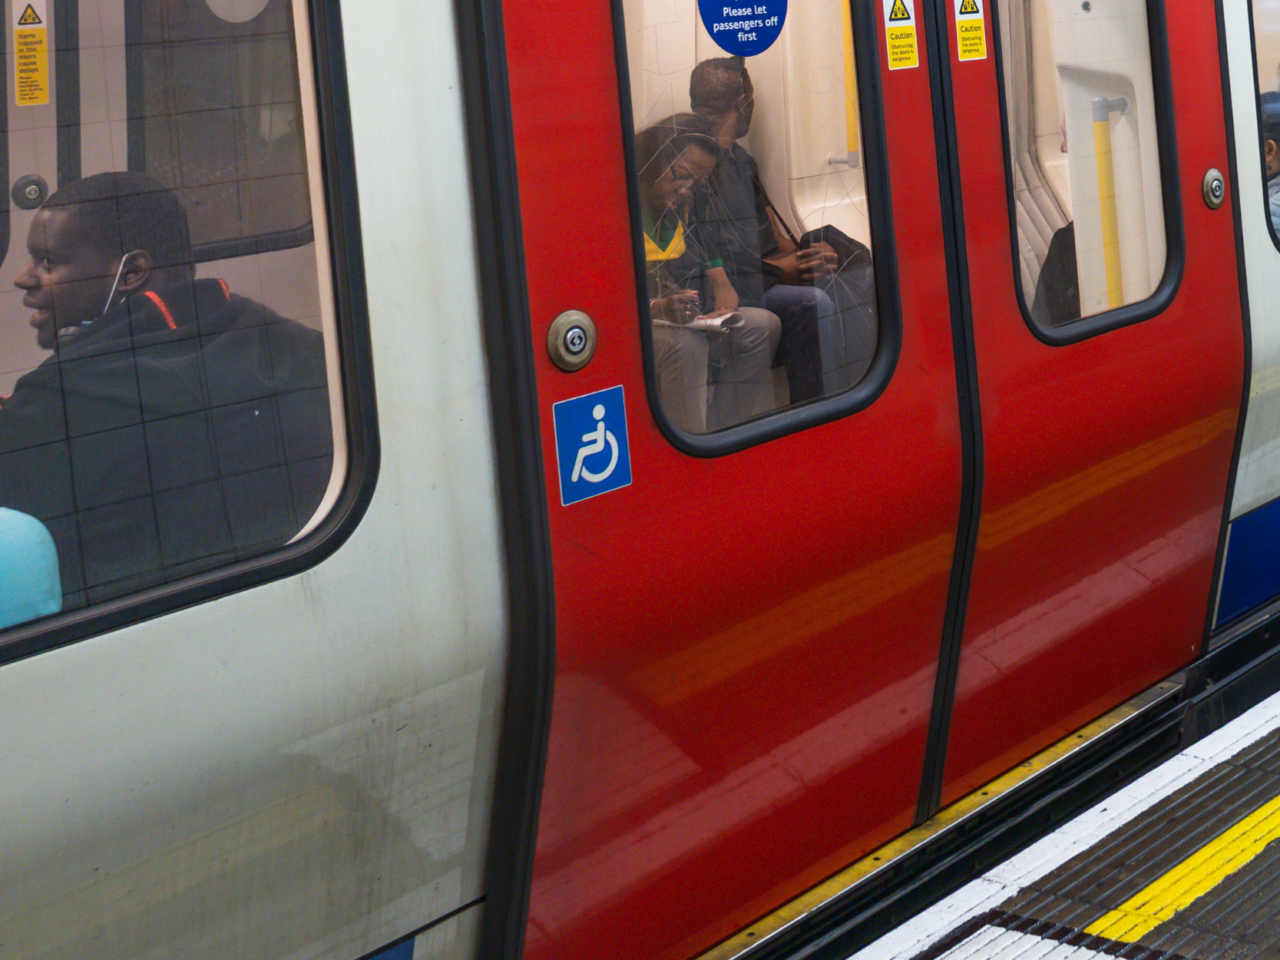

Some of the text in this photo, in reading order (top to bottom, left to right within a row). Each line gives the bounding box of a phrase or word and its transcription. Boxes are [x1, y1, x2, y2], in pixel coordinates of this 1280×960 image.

[723, 4, 767, 17] Please let
[713, 16, 778, 33] passengers off
[960, 25, 981, 33] Caution
[738, 31, 757, 42] first
[890, 32, 913, 40] Caution
[18, 39, 42, 47] trapped
